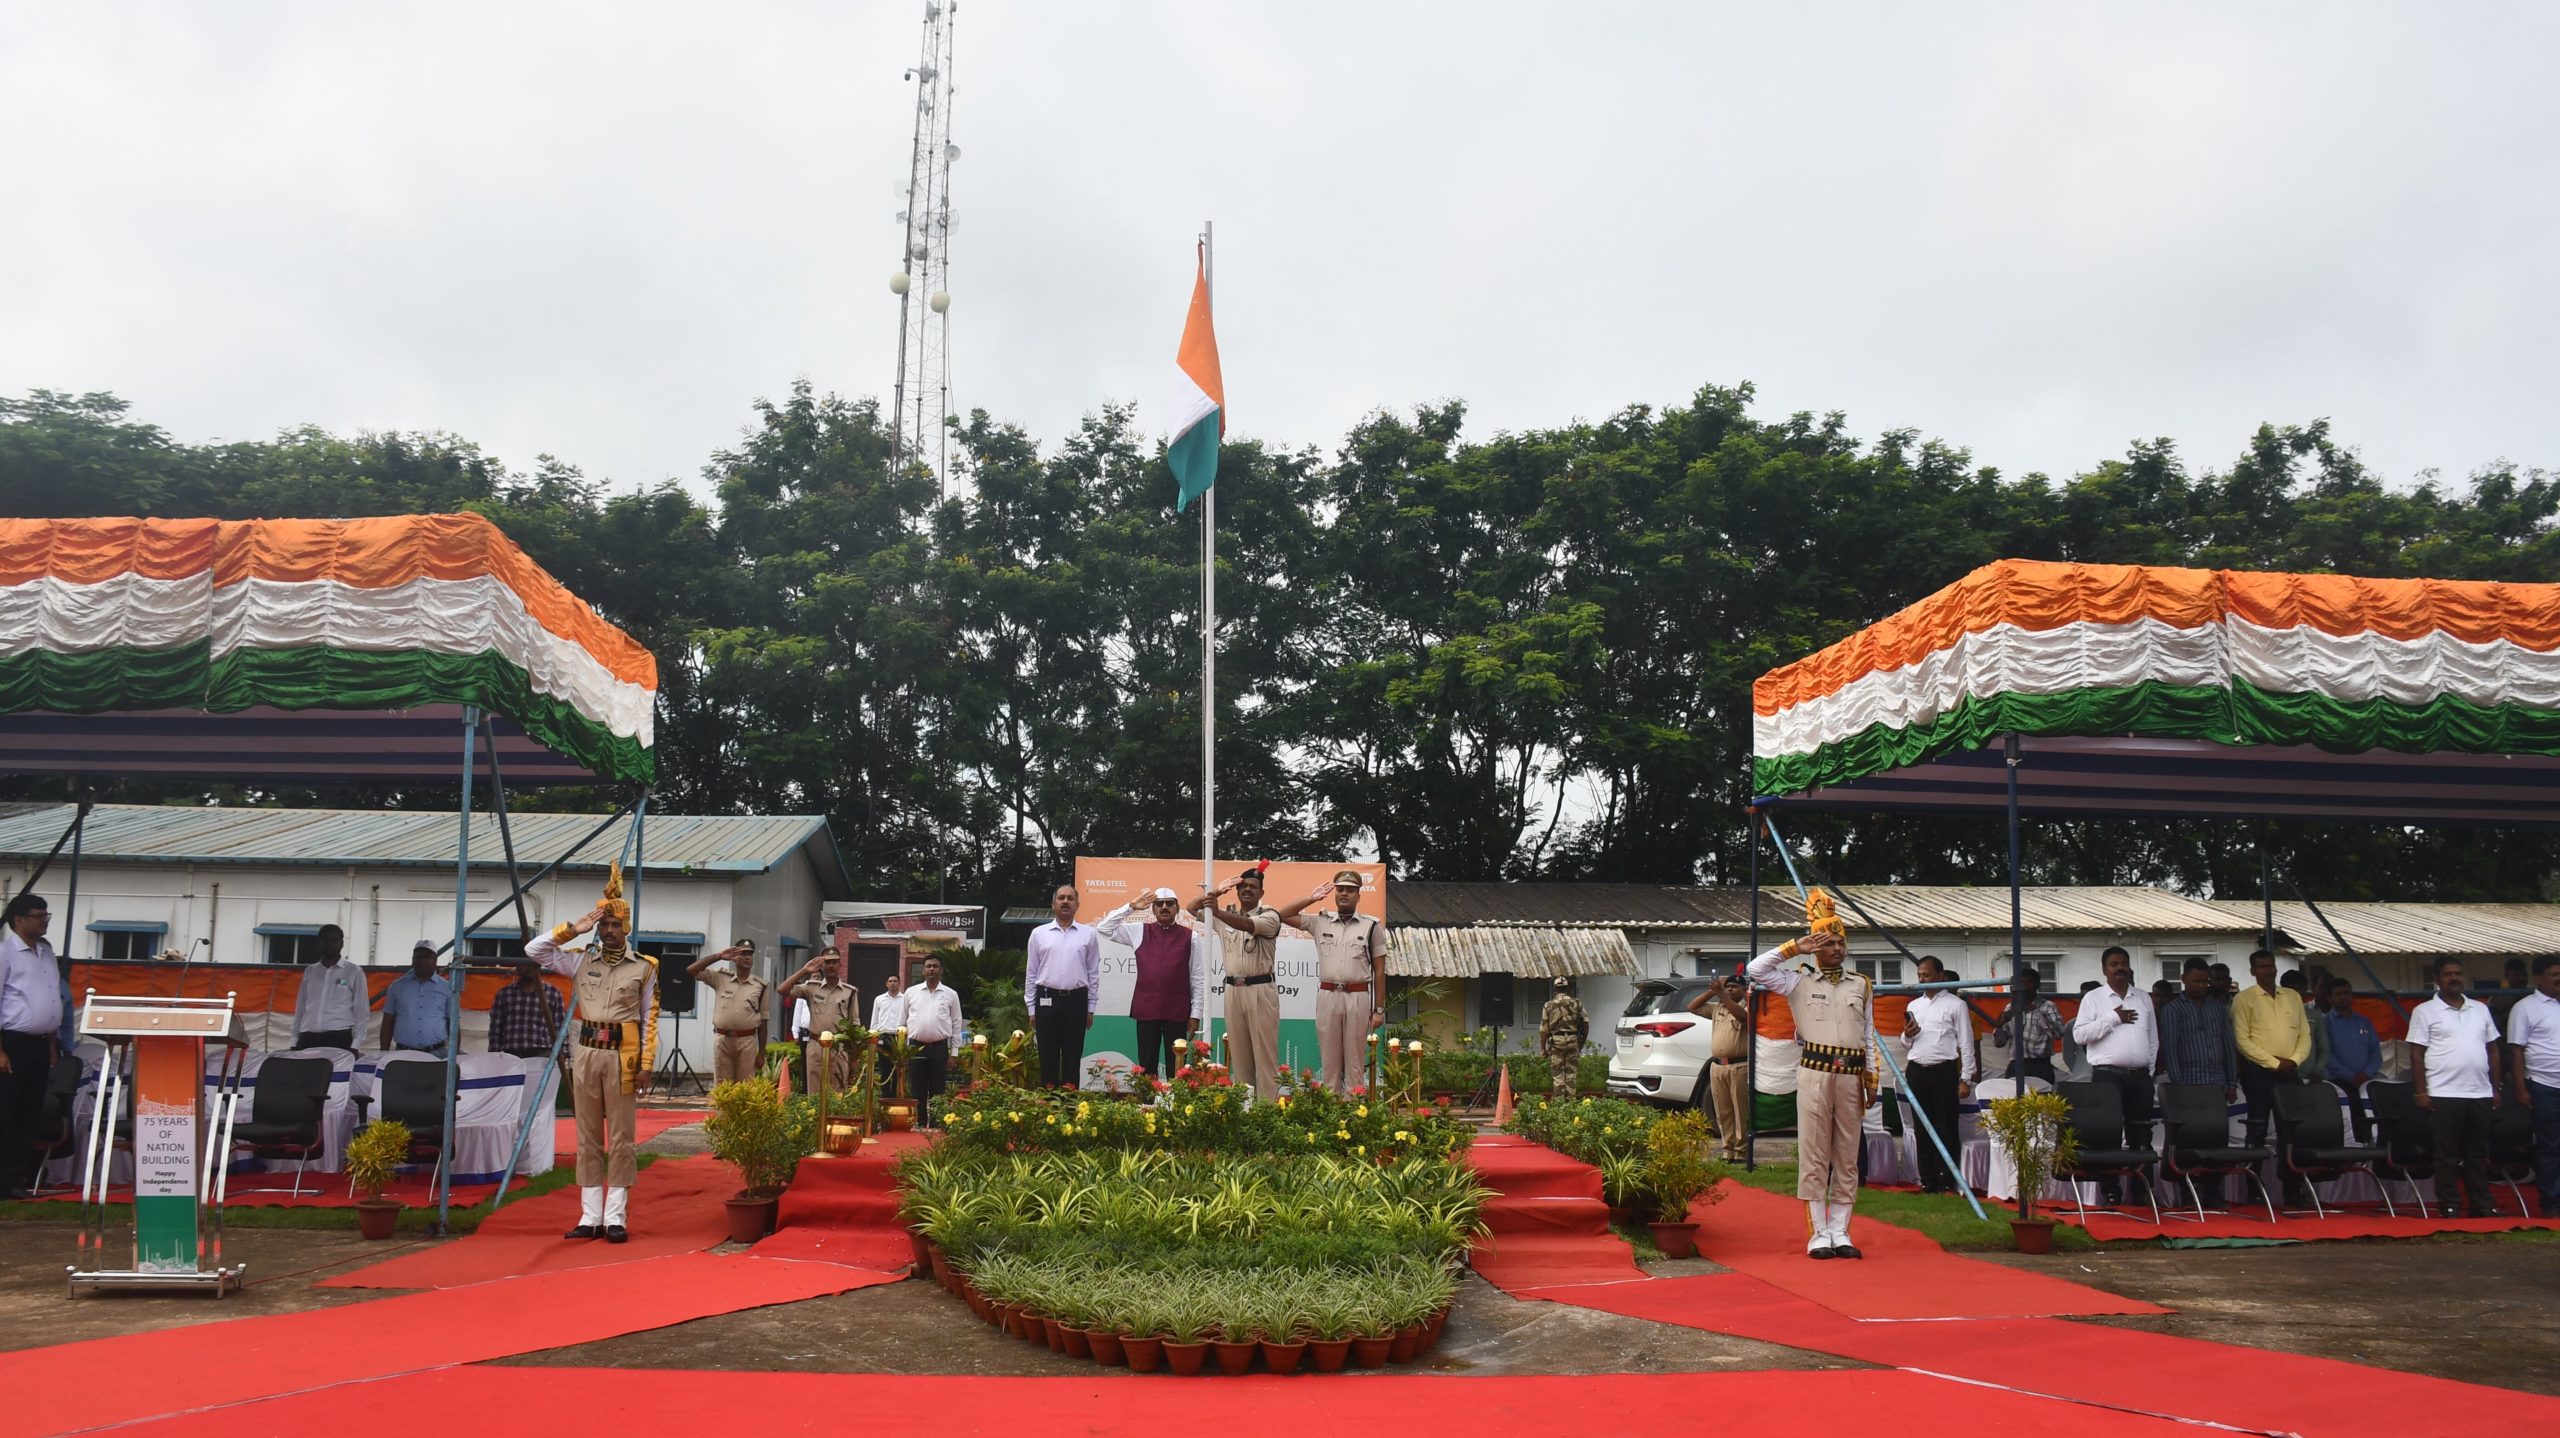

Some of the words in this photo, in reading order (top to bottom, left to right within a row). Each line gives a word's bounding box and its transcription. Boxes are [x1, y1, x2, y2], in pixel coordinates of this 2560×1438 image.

[1277, 960, 1320, 977] BUIL
[1278, 985, 1299, 996] Day
[144, 1117, 155, 1126] 75
[157, 1117, 188, 1126] YEARS
[159, 1130, 172, 1138] OF
[147, 1143, 184, 1151] NATION
[142, 1156, 189, 1164] BUILDING
